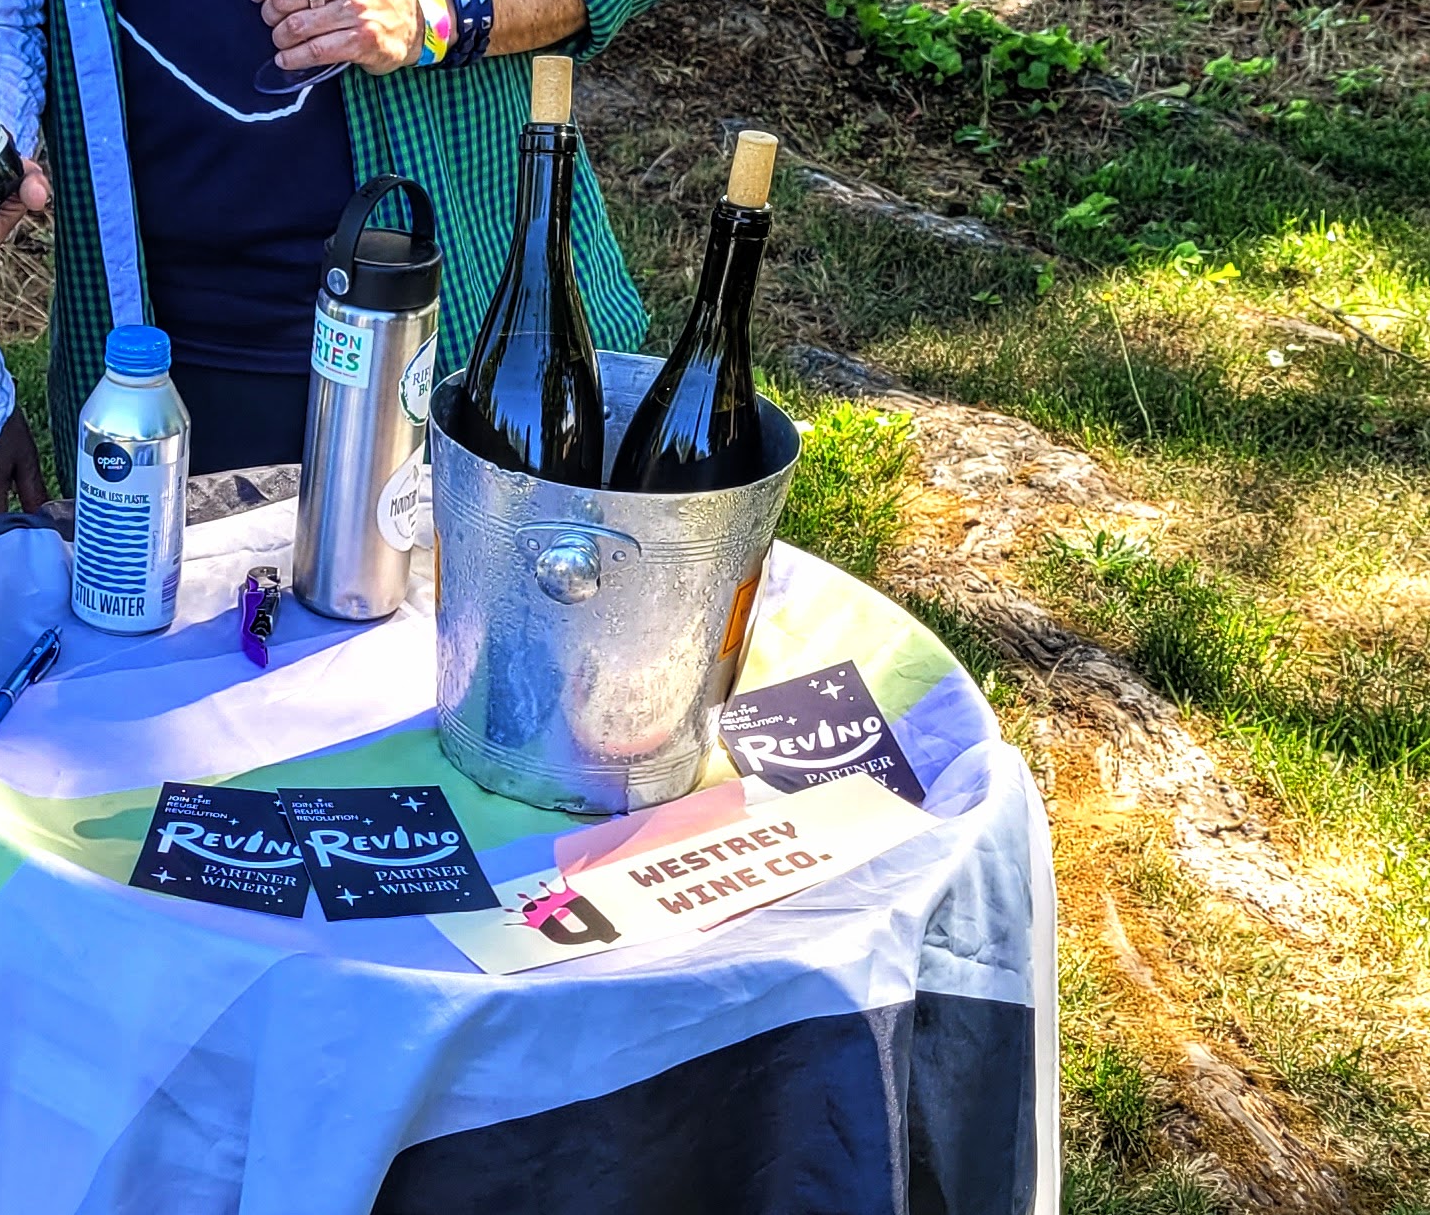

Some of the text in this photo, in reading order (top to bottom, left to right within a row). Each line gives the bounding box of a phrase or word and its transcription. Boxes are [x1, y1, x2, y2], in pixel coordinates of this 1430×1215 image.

[97, 456, 127, 470] open
[108, 491, 124, 503] LESS
[75, 581, 145, 617] STILL WATER
[738, 705, 759, 716] THE
[723, 714, 784, 732] REVOLUTION
[804, 755, 895, 785] PARTNER
[166, 801, 199, 810] REUSE
[168, 795, 212, 805] JOIN THE
[164, 807, 229, 820] REVOLUTION
[295, 814, 359, 822] REVOLUTION
[628, 821, 798, 887] WESTREY
[203, 864, 297, 887] PARTNER
[374, 865, 469, 882] PARTNER
[200, 875, 282, 896] WINERY
[379, 879, 460, 895] WINERY
[656, 850, 833, 915] WINE CO.
